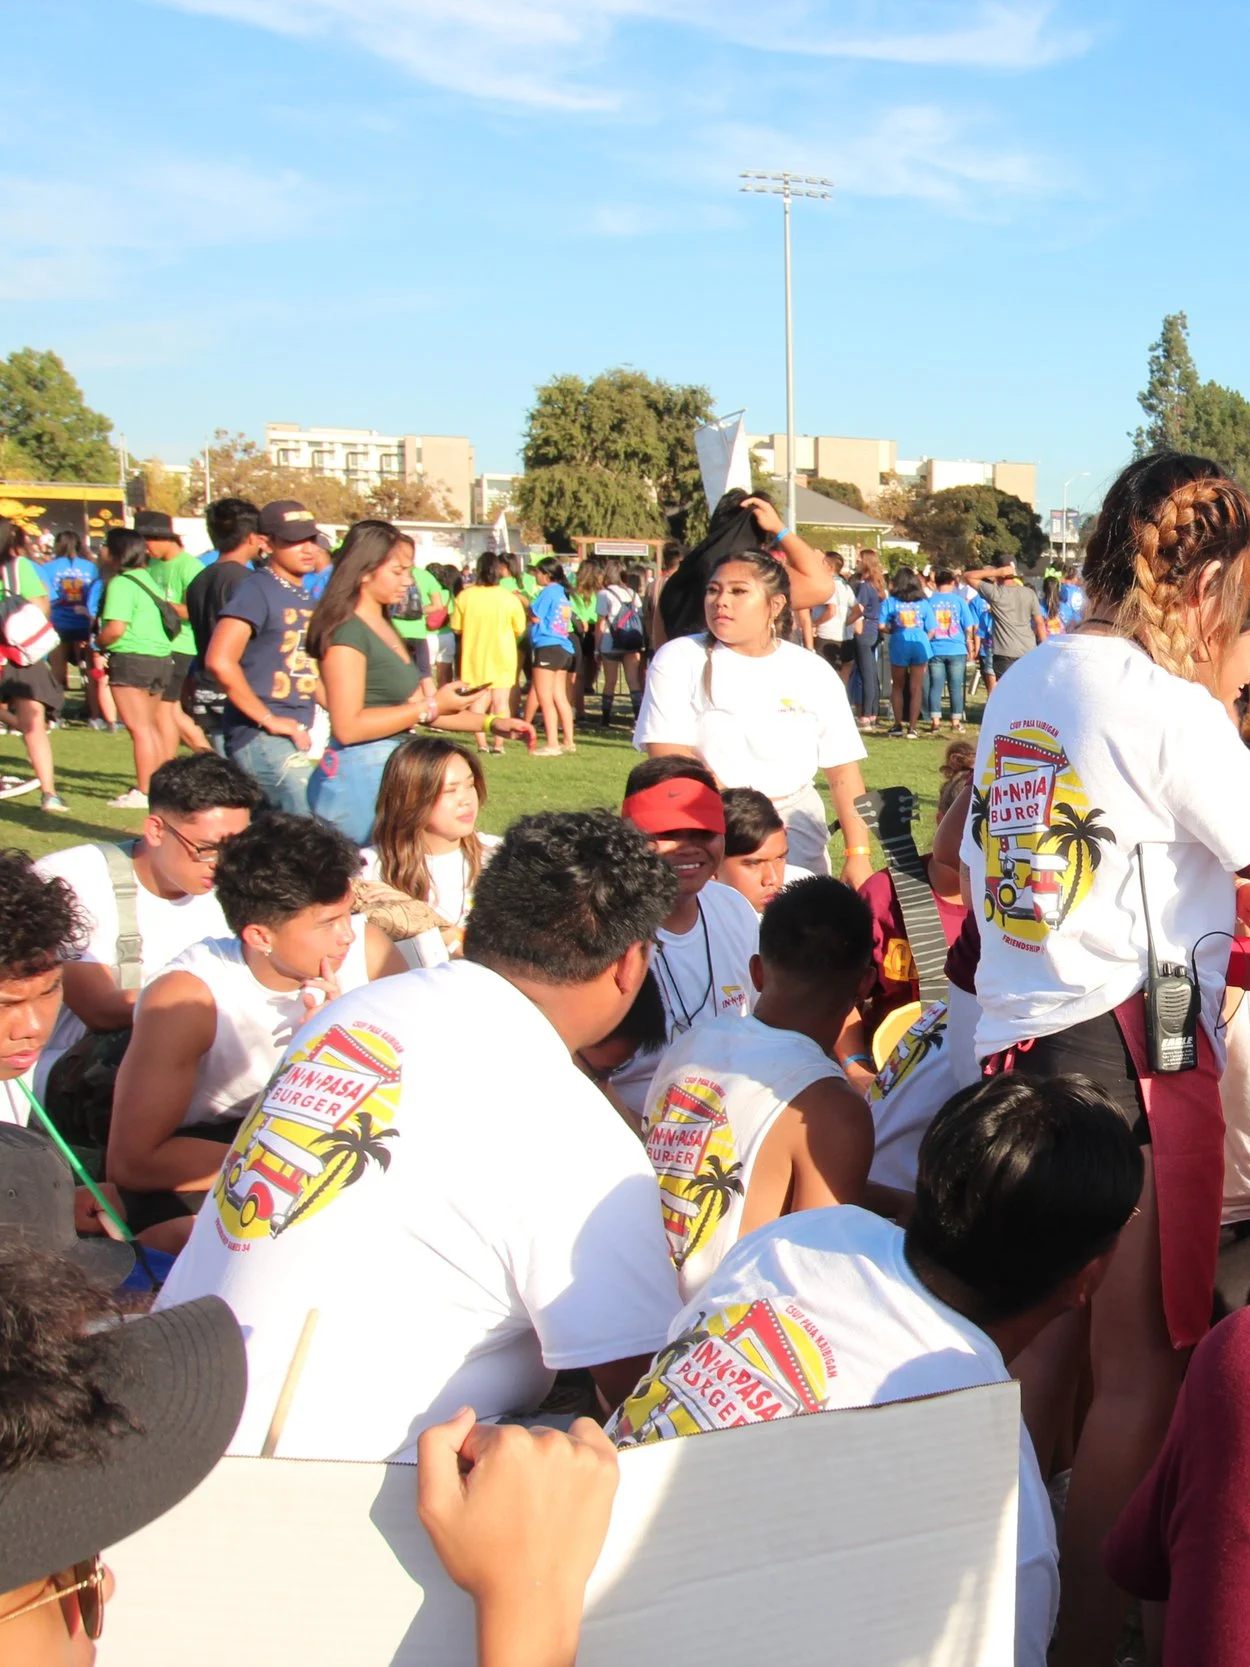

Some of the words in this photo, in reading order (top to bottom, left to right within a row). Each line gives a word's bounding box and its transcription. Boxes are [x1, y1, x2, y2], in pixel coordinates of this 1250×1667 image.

[1002, 934, 1041, 953] FRIENDSHIP
[272, 1087, 342, 1117] BURGER
[800, 1317, 819, 1339] PASA
[816, 1333, 839, 1379] KAIBIGAN
